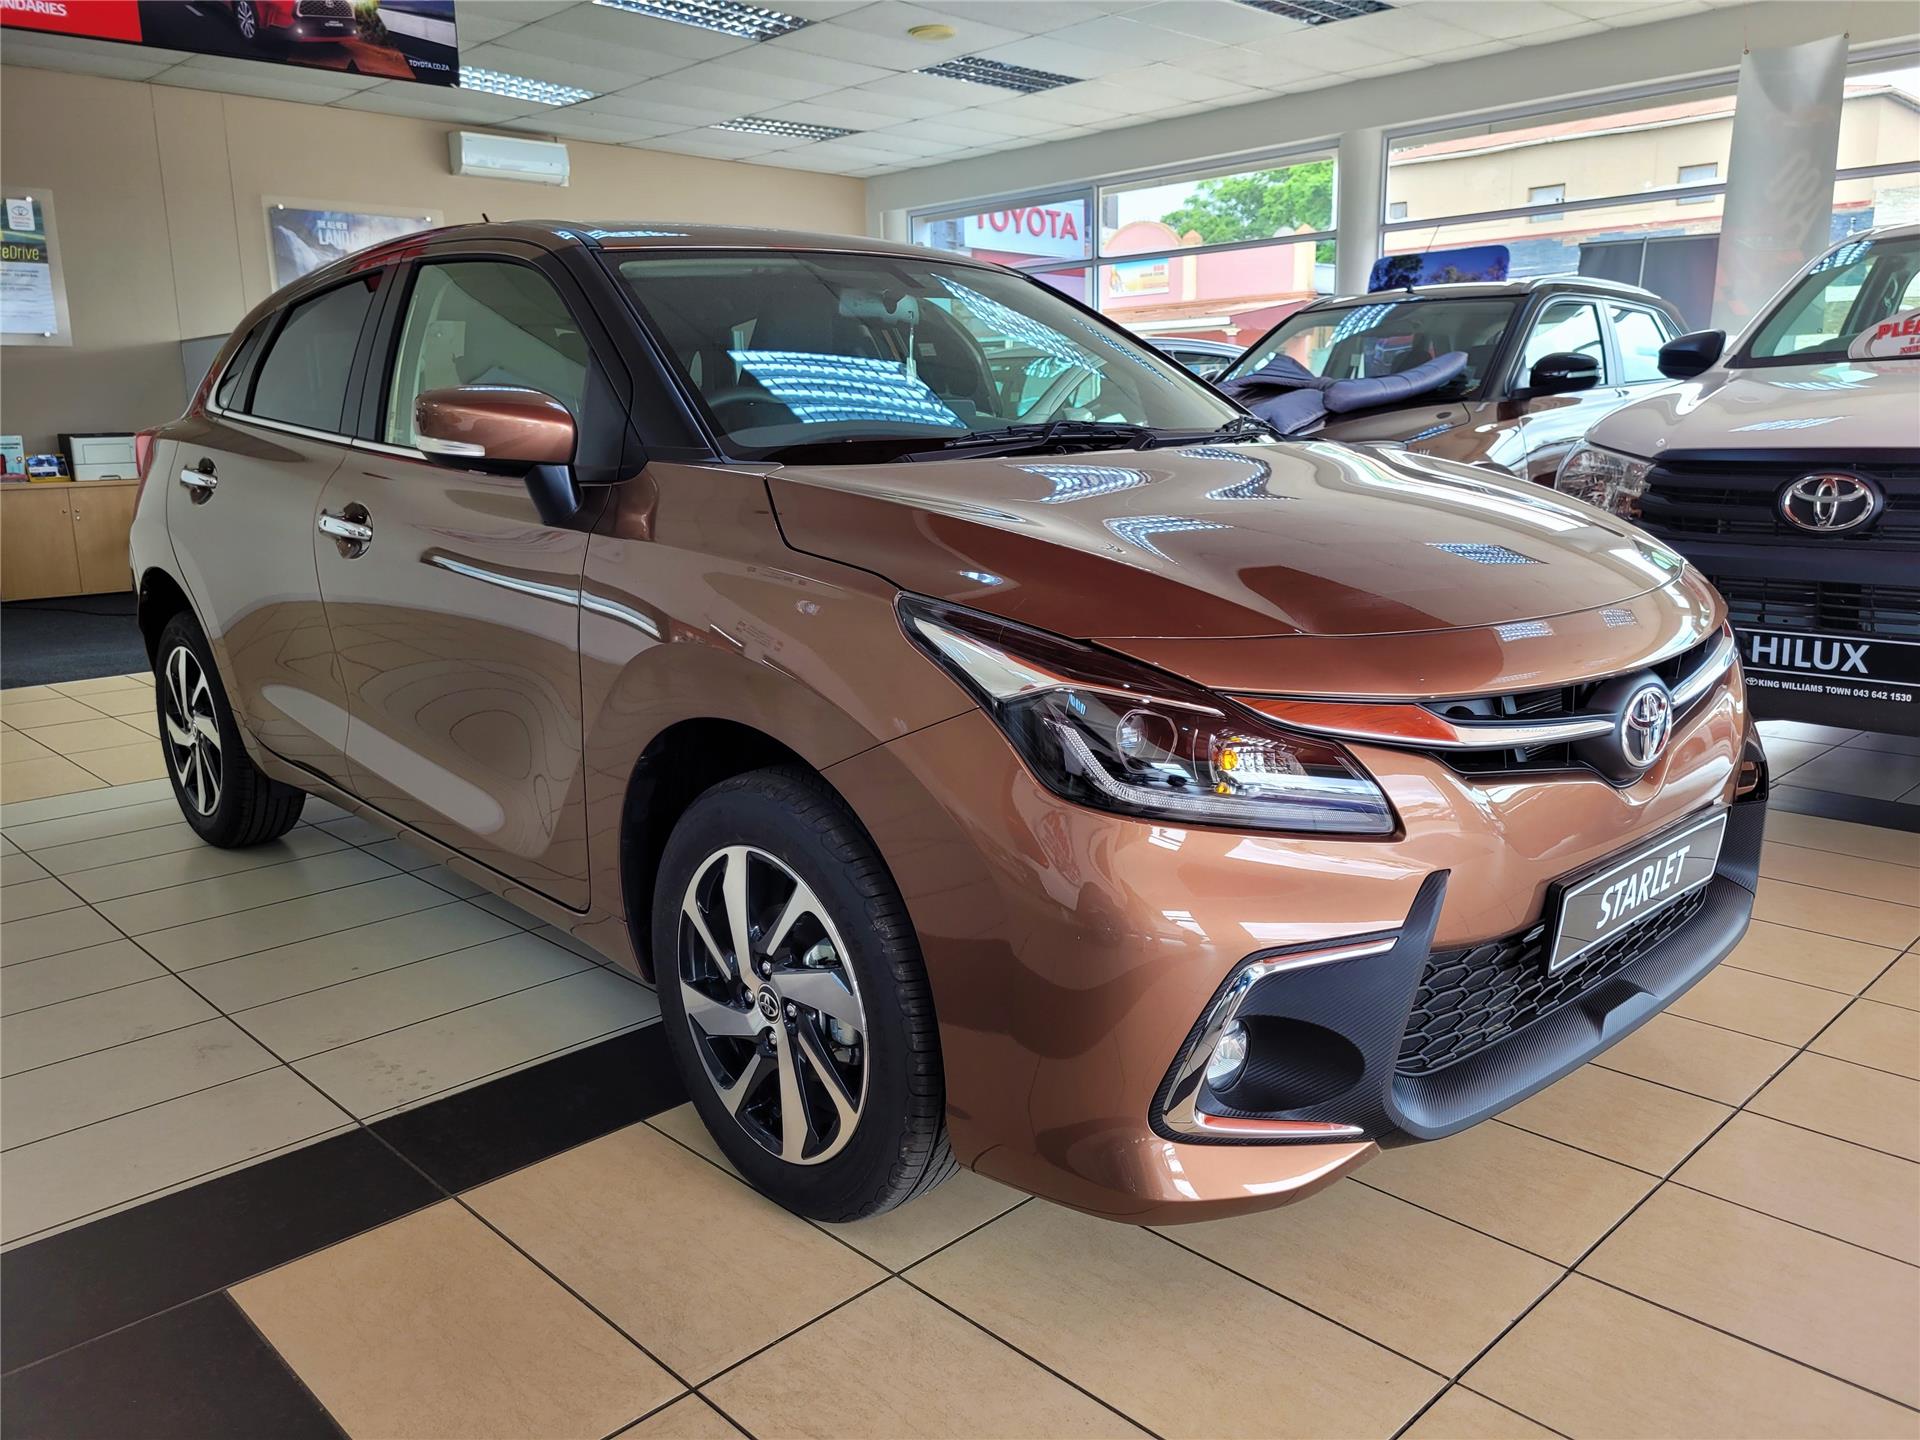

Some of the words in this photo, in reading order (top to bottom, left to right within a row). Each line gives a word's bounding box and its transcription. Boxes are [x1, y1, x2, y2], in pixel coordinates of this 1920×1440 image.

[408, 59, 450, 71] TOYOTA.CO.ZA
[318, 229, 350, 249] LAND
[0, 245, 40, 260] eDrive
[1751, 635, 1870, 674] HILUX
[1758, 679, 1780, 689] KING
[1781, 681, 1824, 693] WILLIAMS
[1825, 686, 1851, 696] TOWN
[1853, 688, 1869, 698] 043
[1871, 691, 1888, 701] 642
[1890, 693, 1912, 703] 1530
[1595, 845, 1691, 930] STARLET
